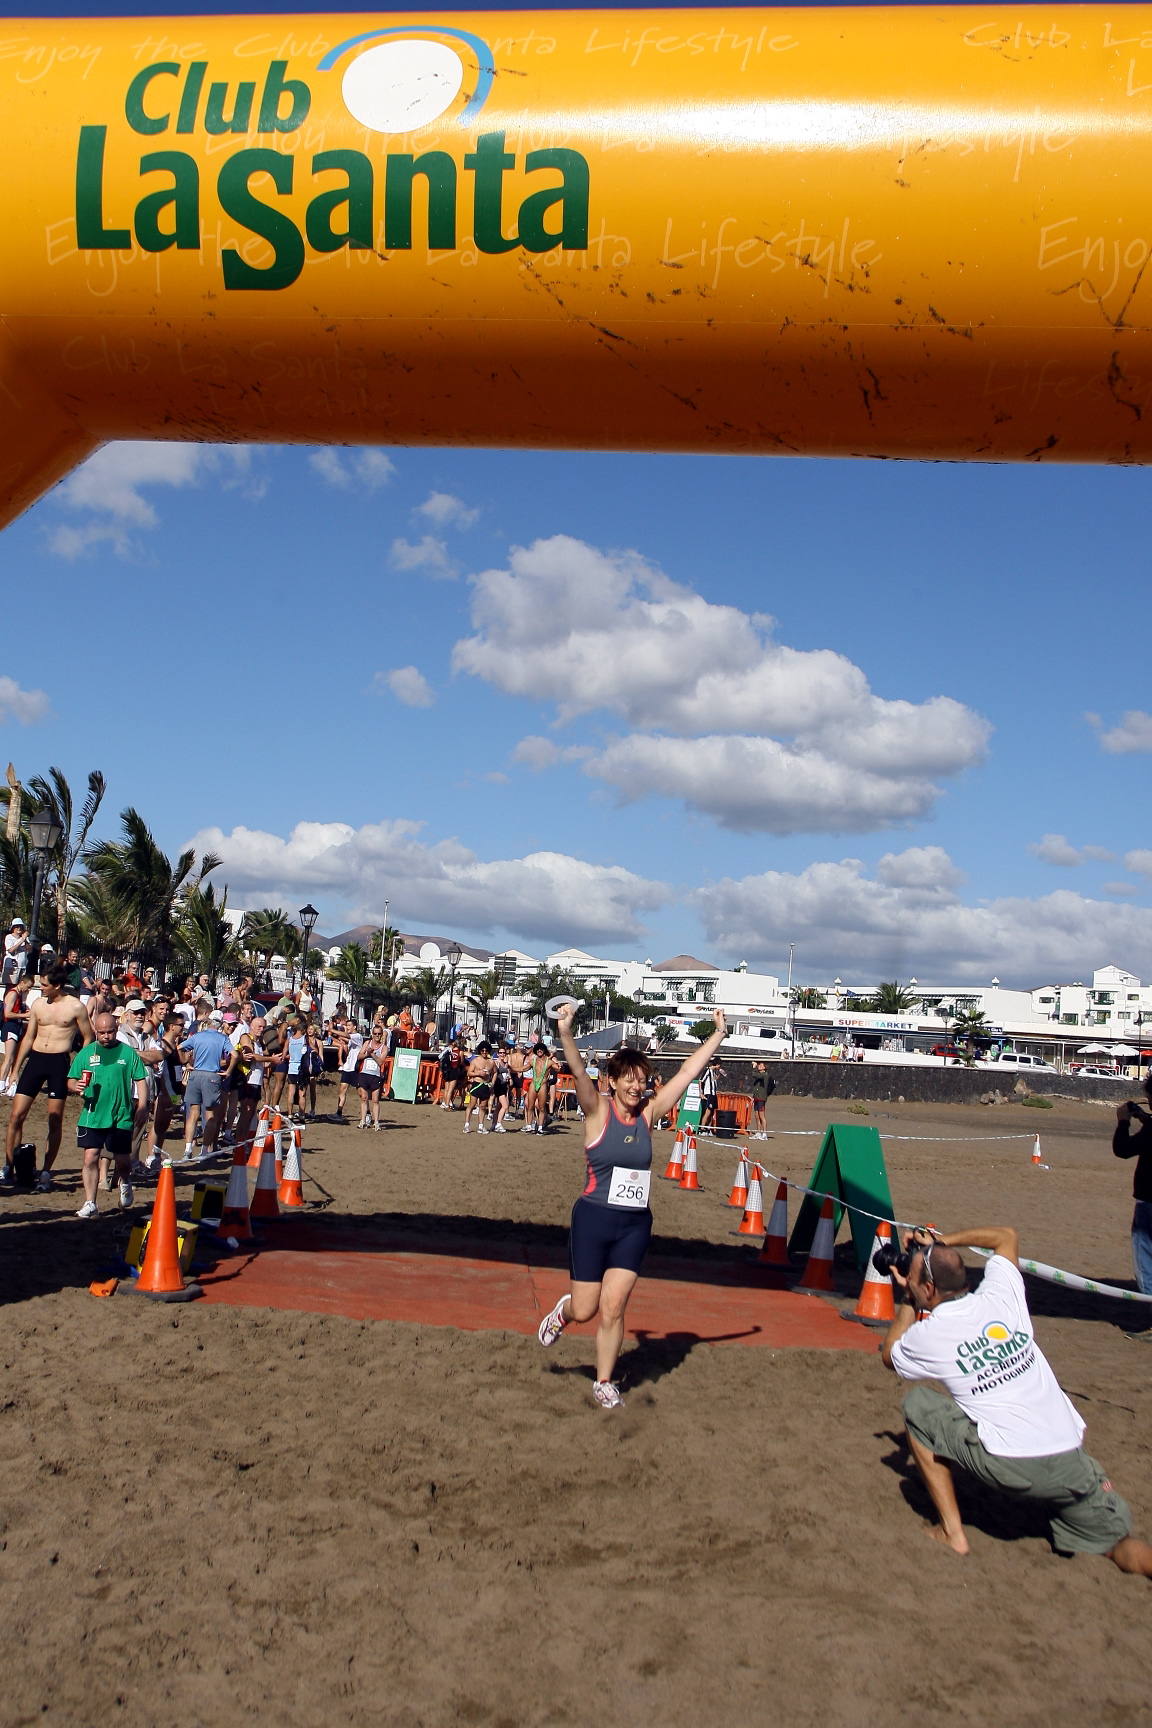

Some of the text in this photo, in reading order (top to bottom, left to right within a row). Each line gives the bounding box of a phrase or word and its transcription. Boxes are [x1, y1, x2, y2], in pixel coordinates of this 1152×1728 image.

[962, 22, 1072, 49] Club
[0, 36, 103, 83] Enjoy
[131, 34, 206, 62] the
[233, 31, 331, 61] Club
[439, 29, 557, 58] Snta
[584, 24, 800, 72] Lifestyle
[125, 59, 312, 137] Club
[662, 216, 884, 299] Lifestyle
[838, 1019, 872, 1028] SUPER
[616, 1184, 644, 1200] 256
[956, 1335, 990, 1359] Club
